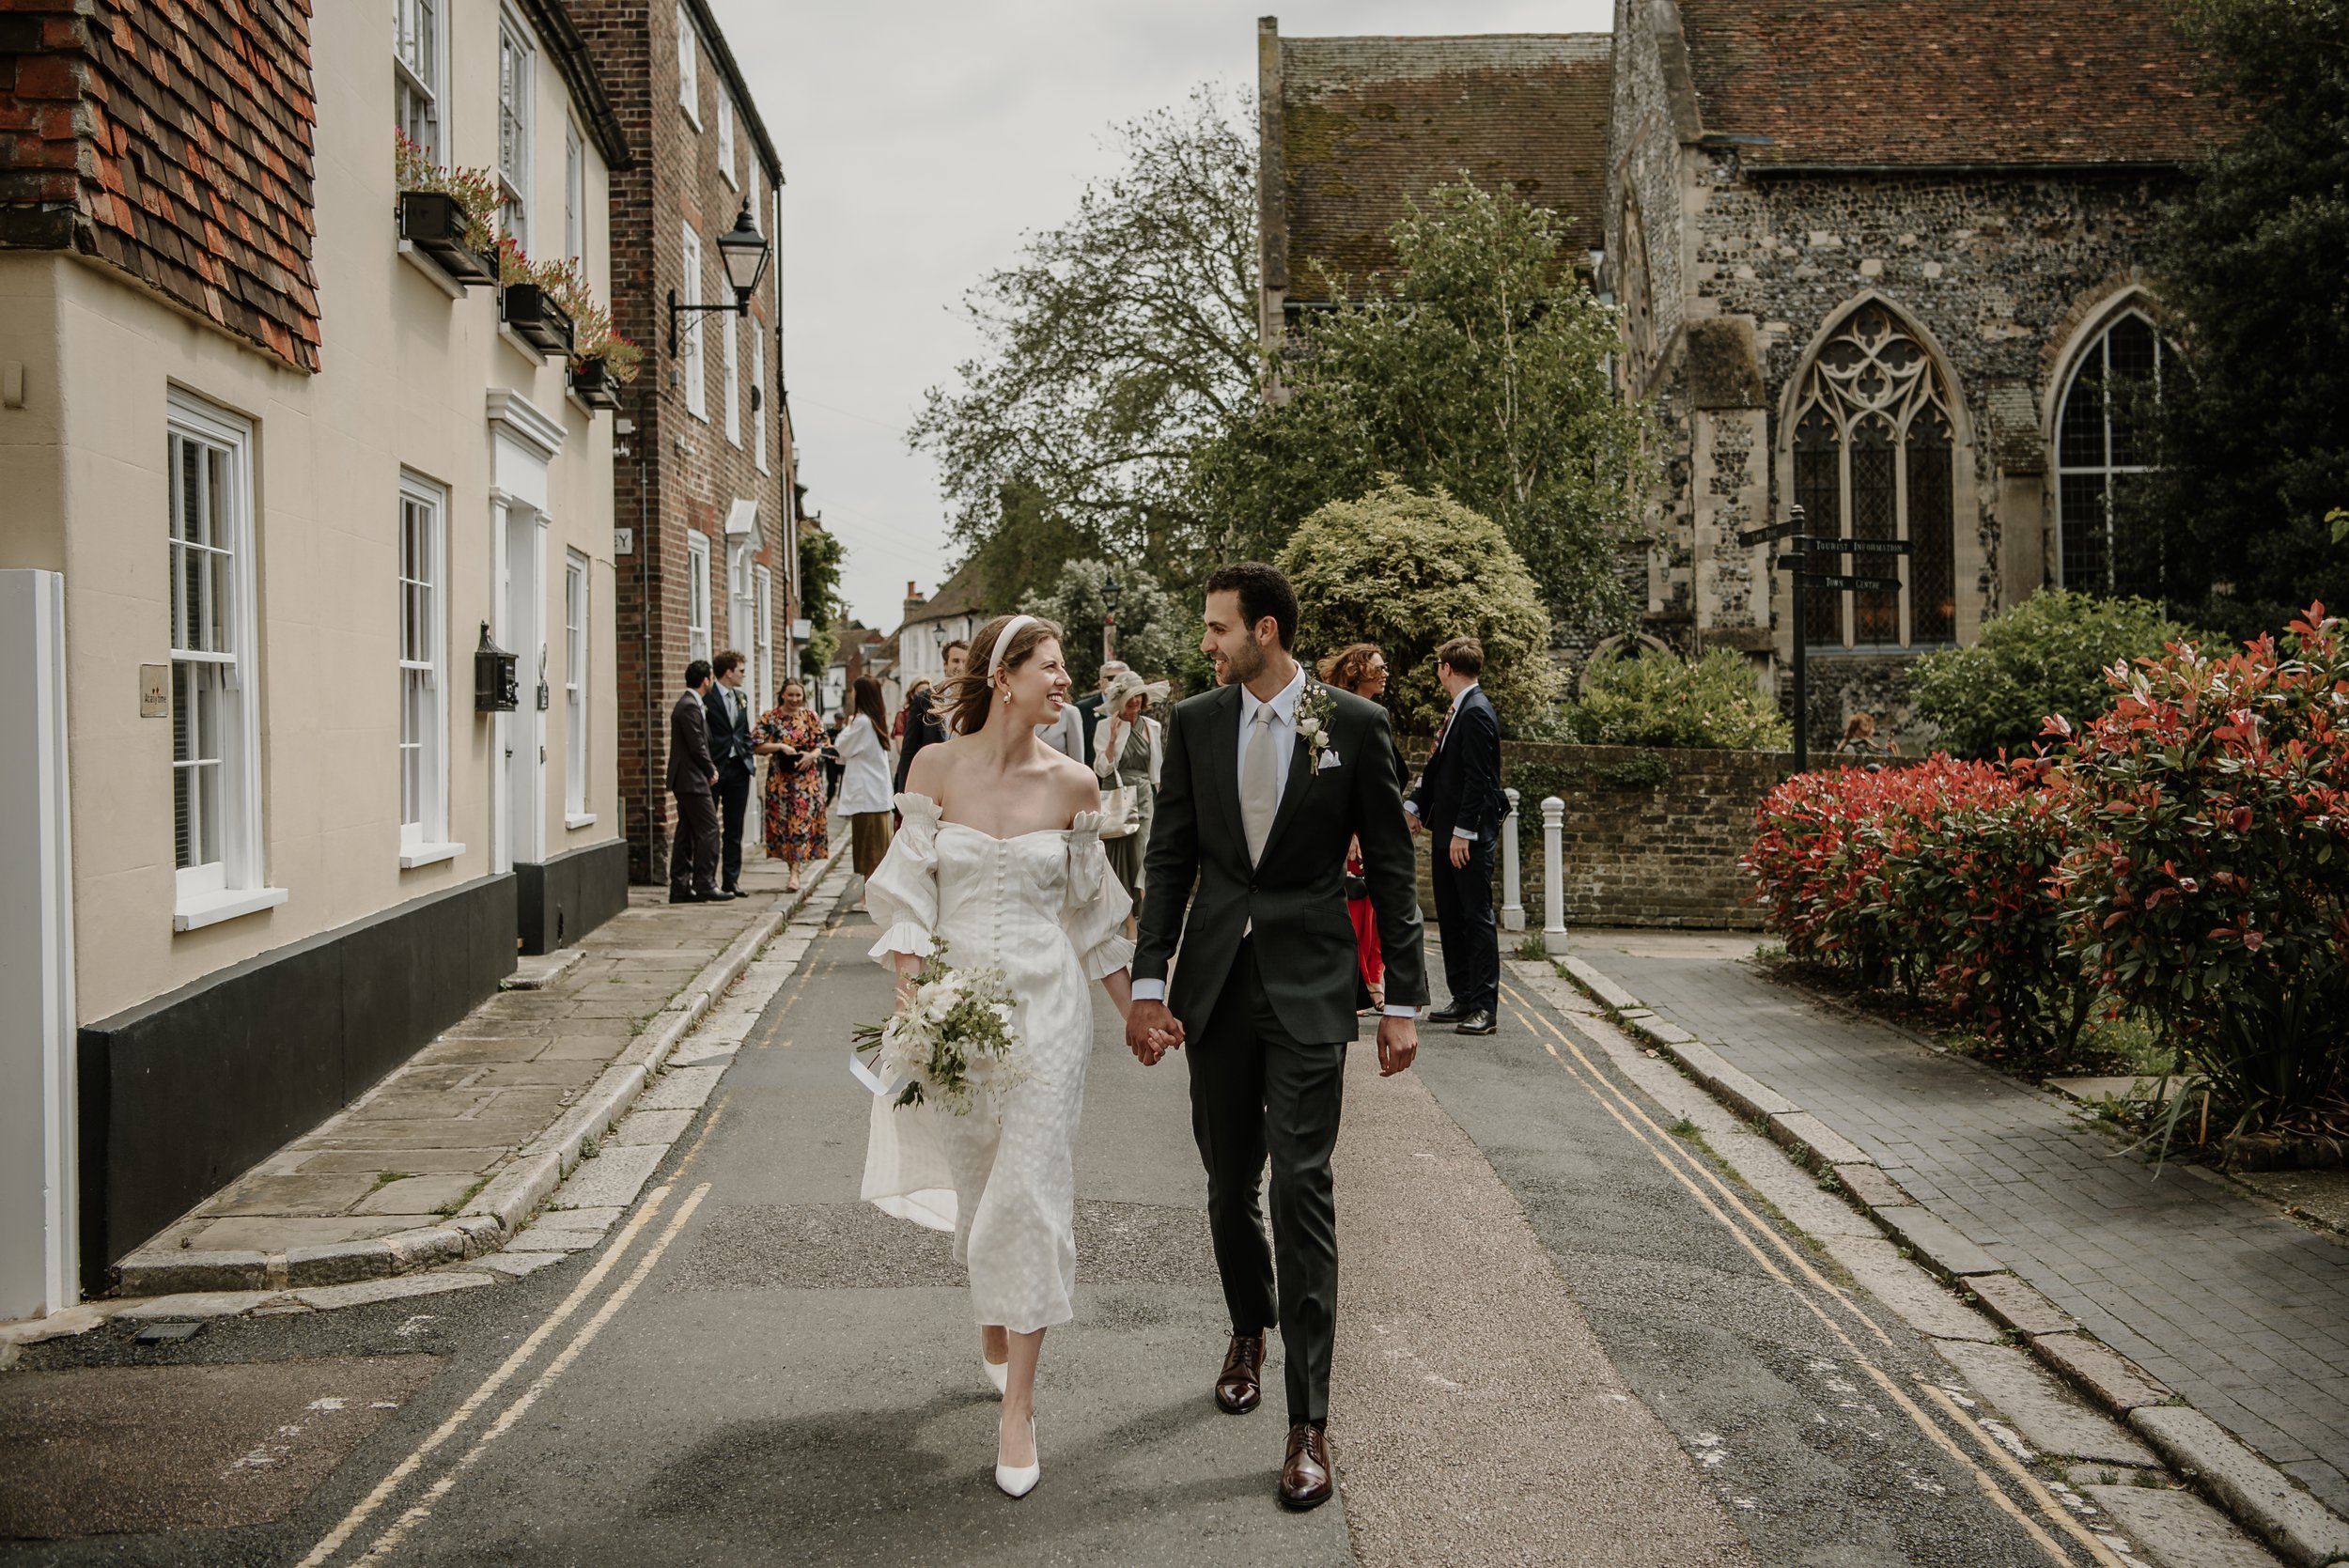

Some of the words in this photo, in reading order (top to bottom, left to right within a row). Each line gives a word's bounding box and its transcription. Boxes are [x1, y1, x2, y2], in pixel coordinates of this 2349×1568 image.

[1816, 541, 1848, 551] TOURIST
[1854, 542, 1903, 552] INFORMATION
[1826, 577, 1843, 587] TOWN
[1855, 579, 1880, 590] CENTRE
